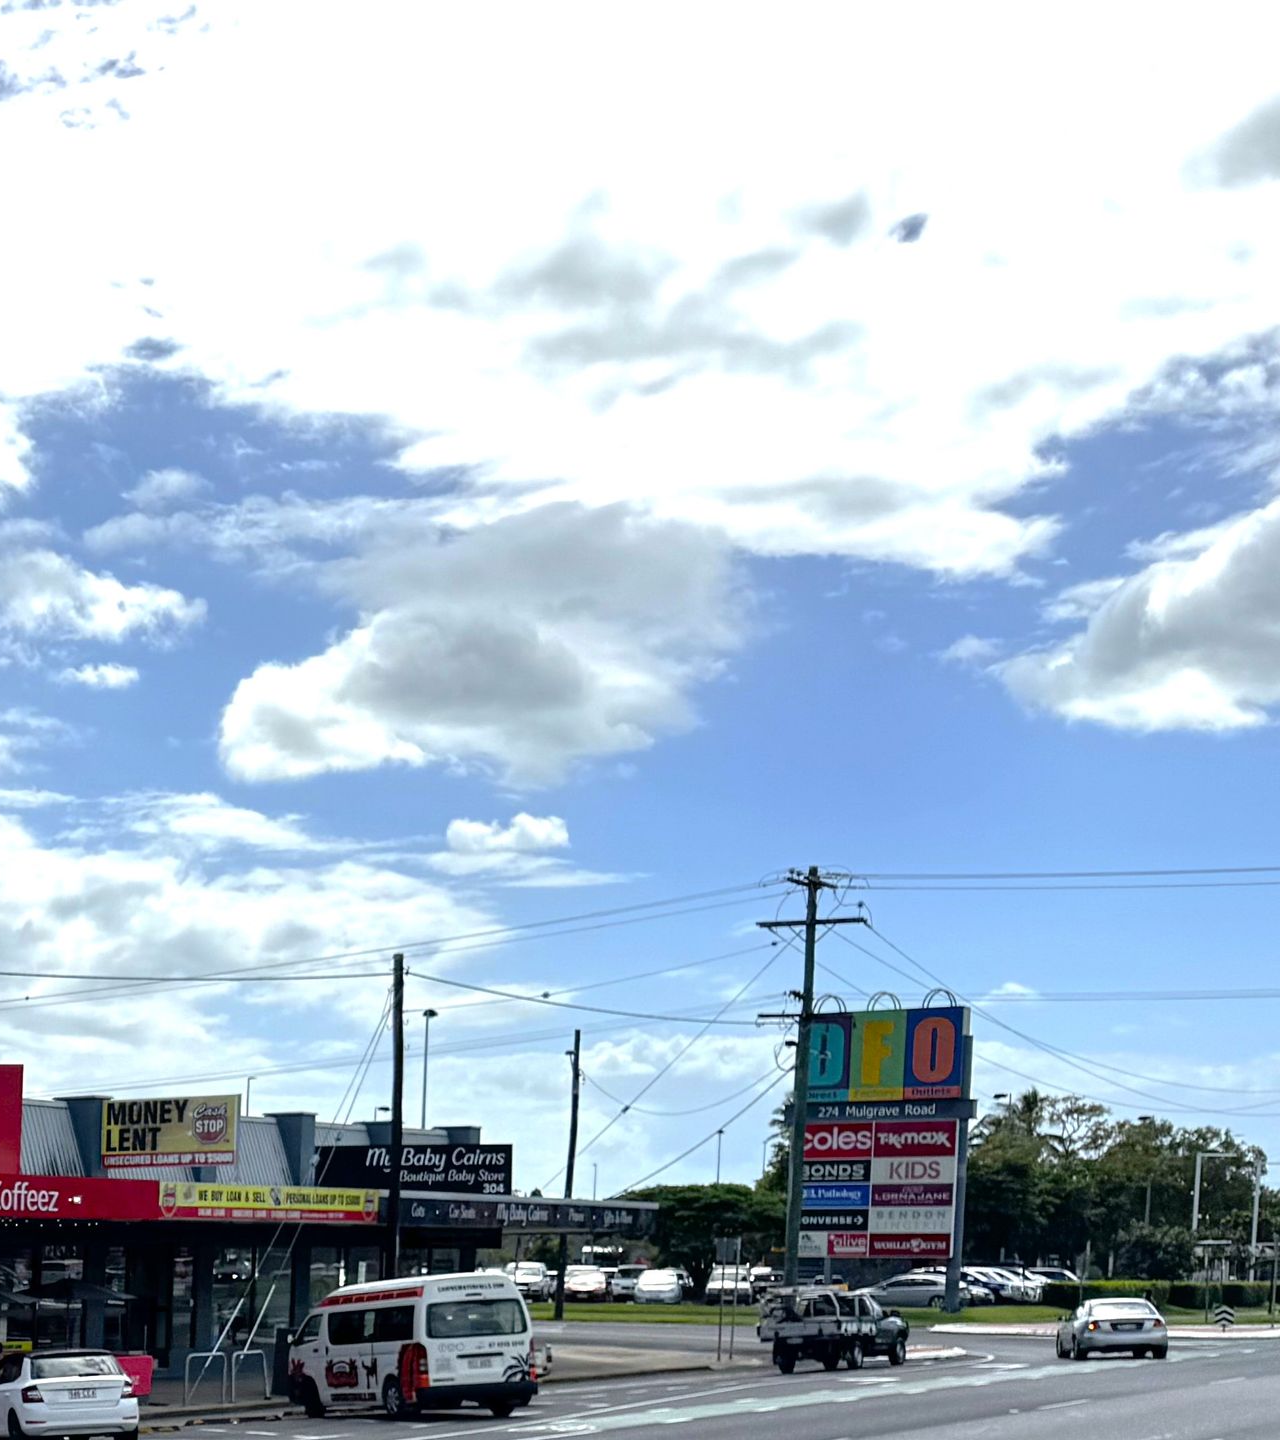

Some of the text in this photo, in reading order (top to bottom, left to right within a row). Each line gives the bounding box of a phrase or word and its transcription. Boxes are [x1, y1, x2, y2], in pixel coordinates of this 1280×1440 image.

[106, 1099, 189, 1126] MONEY
[193, 1103, 228, 1118] Cash
[818, 1103, 936, 1118] 274 Mulgrave Road
[195, 1119, 224, 1133] STOP
[105, 1128, 161, 1152] LENT
[152, 1154, 179, 1164] LOANS
[180, 1153, 192, 1164] UP
[194, 1153, 205, 1163] TO
[401, 1149, 445, 1172] Baby
[452, 1147, 505, 1166] Cairns
[399, 1169, 505, 1186] Boutique Baby Store
[890, 1161, 940, 1180] KIDS
[483, 1183, 505, 1194] 304
[198, 1190, 208, 1201] WE
[252, 1192, 266, 1203] SELL
[801, 1215, 853, 1225] ONVERSE
[876, 1210, 946, 1220] BENDON
